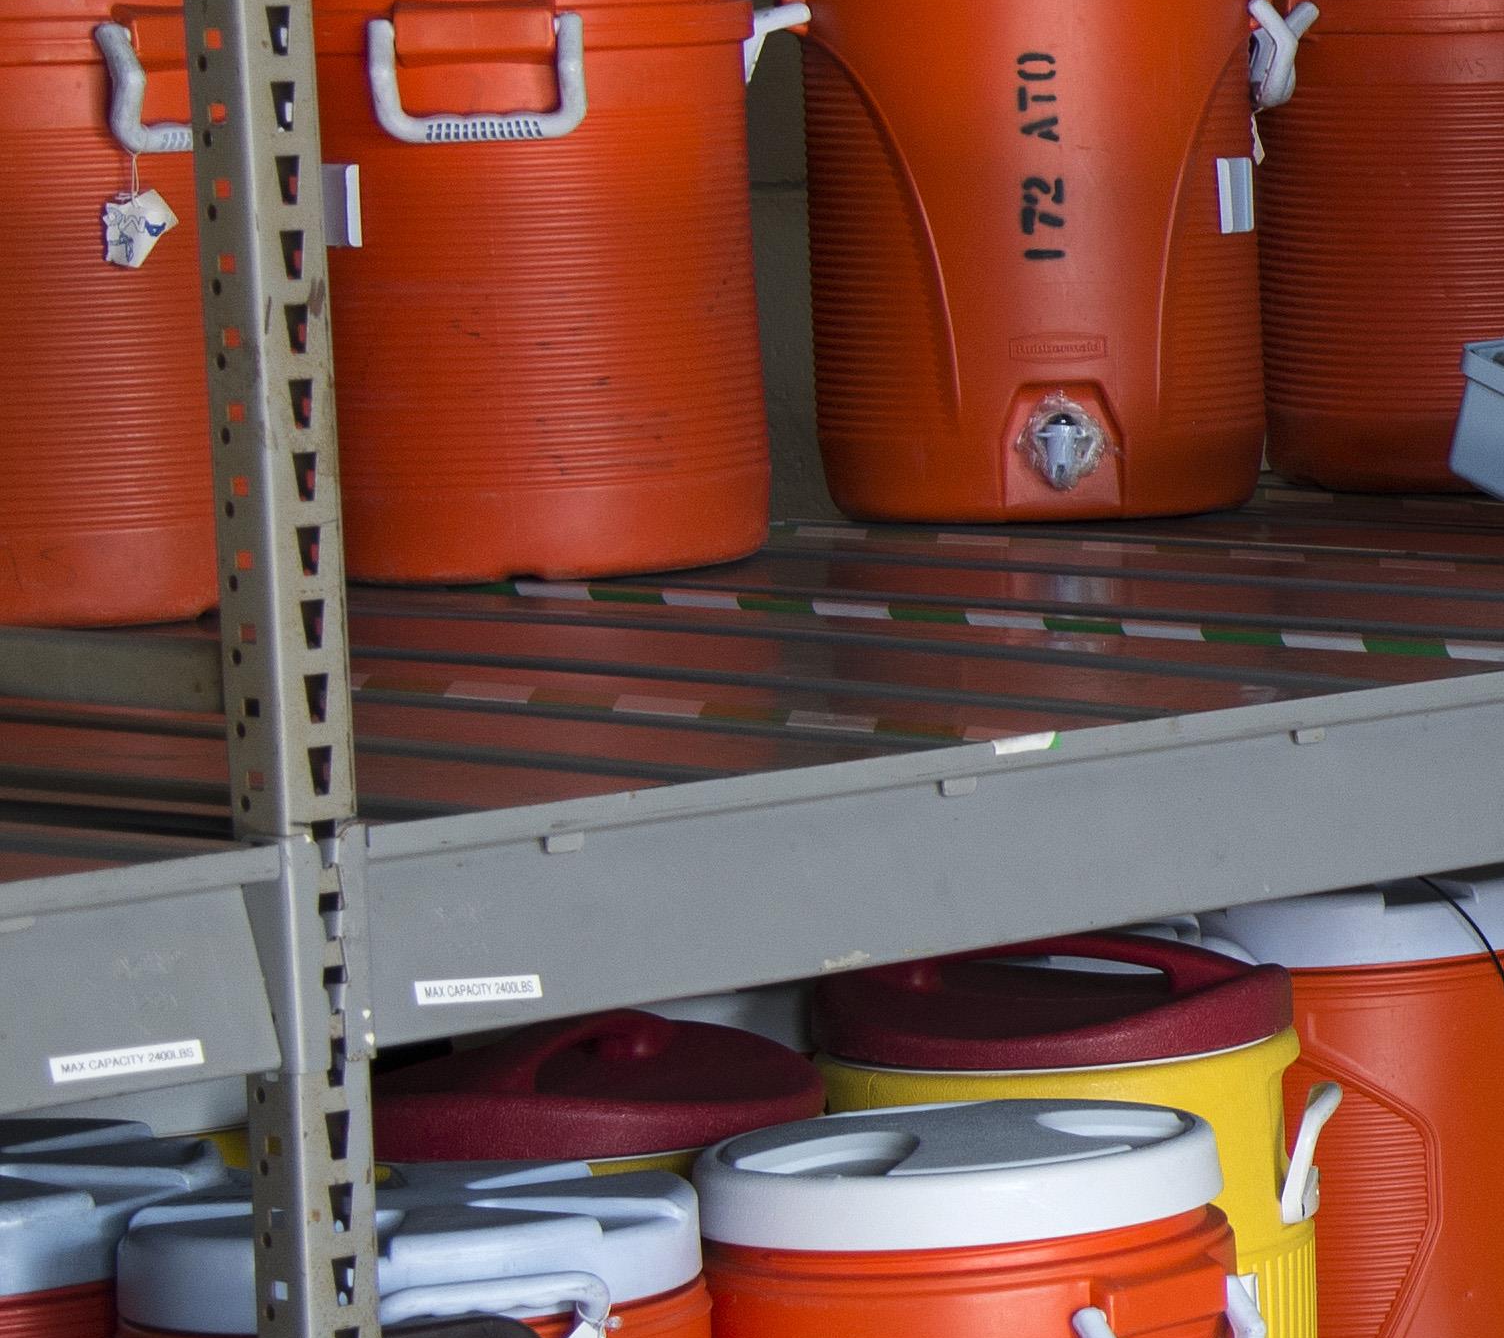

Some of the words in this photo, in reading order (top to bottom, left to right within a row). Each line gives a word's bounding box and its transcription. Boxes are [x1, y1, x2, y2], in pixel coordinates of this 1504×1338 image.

[1017, 52, 1059, 142] ATO
[1021, 177, 1066, 260] 172
[424, 986, 445, 999] MAX
[447, 982, 493, 998] CAPACITY
[495, 980, 535, 995] 2400LBS
[60, 1062, 86, 1074] MAX
[88, 1053, 146, 1071] CAPACITY
[148, 1046, 195, 1062] 2400LBS
